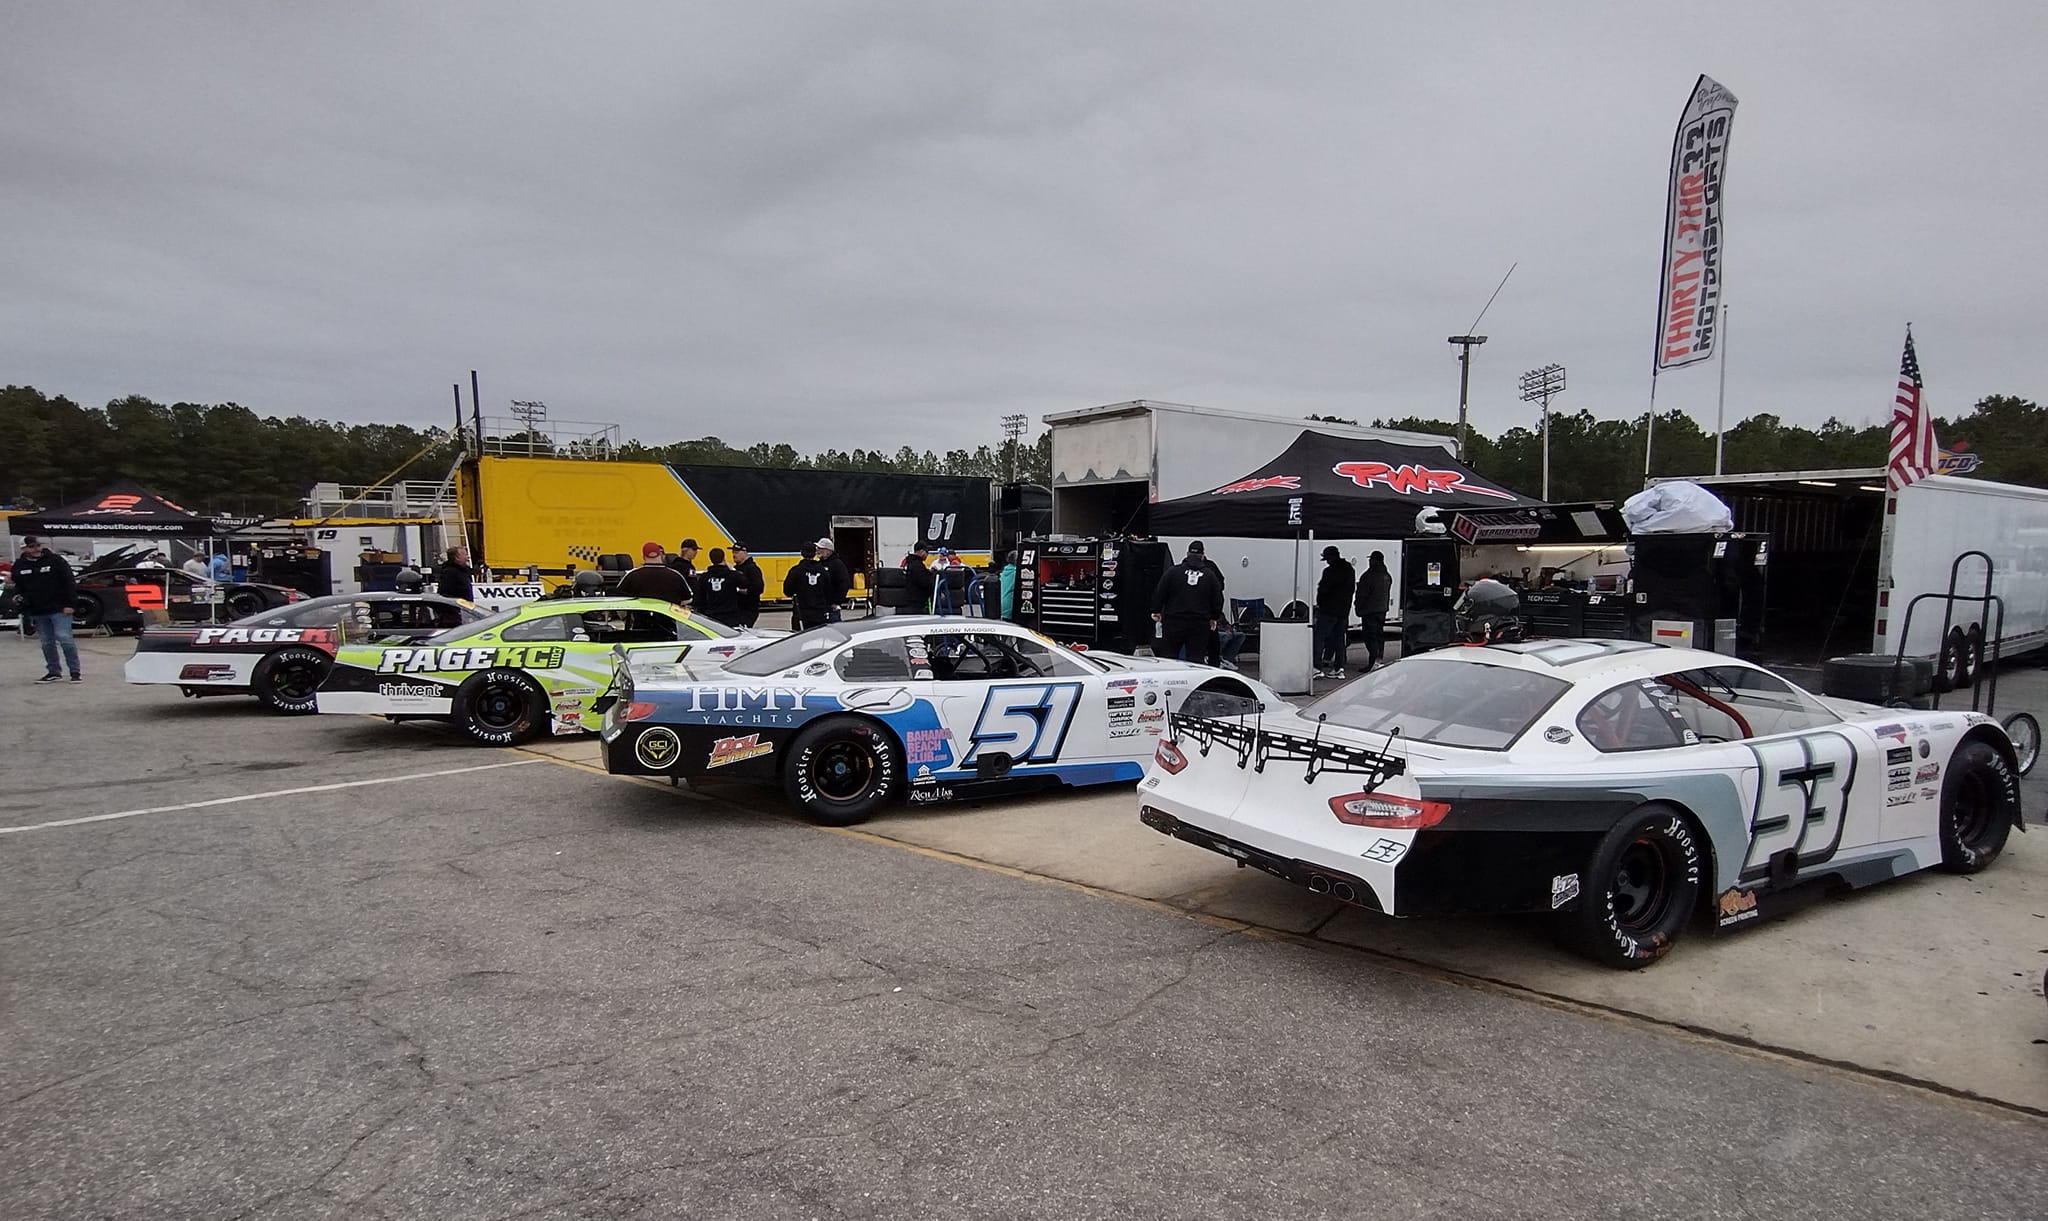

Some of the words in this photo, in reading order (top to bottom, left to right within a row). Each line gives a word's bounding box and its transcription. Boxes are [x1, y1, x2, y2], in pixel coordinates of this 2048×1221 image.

[43, 523, 183, 531] www.walkaboutflooringnc.com
[317, 530, 337, 539] 19
[927, 513, 956, 540] 51
[1021, 550, 1035, 565] 51
[124, 584, 166, 609] 2
[478, 586, 543, 599] WACKER
[279, 652, 321, 664] Hoosier
[379, 683, 442, 697] thrivent
[486, 671, 532, 693] Hoosier
[272, 696, 316, 711] Hoosier
[687, 687, 816, 712] HMY
[702, 714, 793, 724] YACHTS
[959, 682, 1083, 769] 51
[469, 724, 513, 743] Hoosier
[649, 740, 667, 749] GCI
[907, 740, 941, 752] BEACH
[796, 748, 818, 803] Hoosier
[872, 741, 892, 796] Hoosier
[1738, 731, 1858, 885] 53
[1361, 838, 1407, 863] 53
[1664, 817, 1699, 885] Hoosier
[1606, 890, 1638, 958] Hoosier
